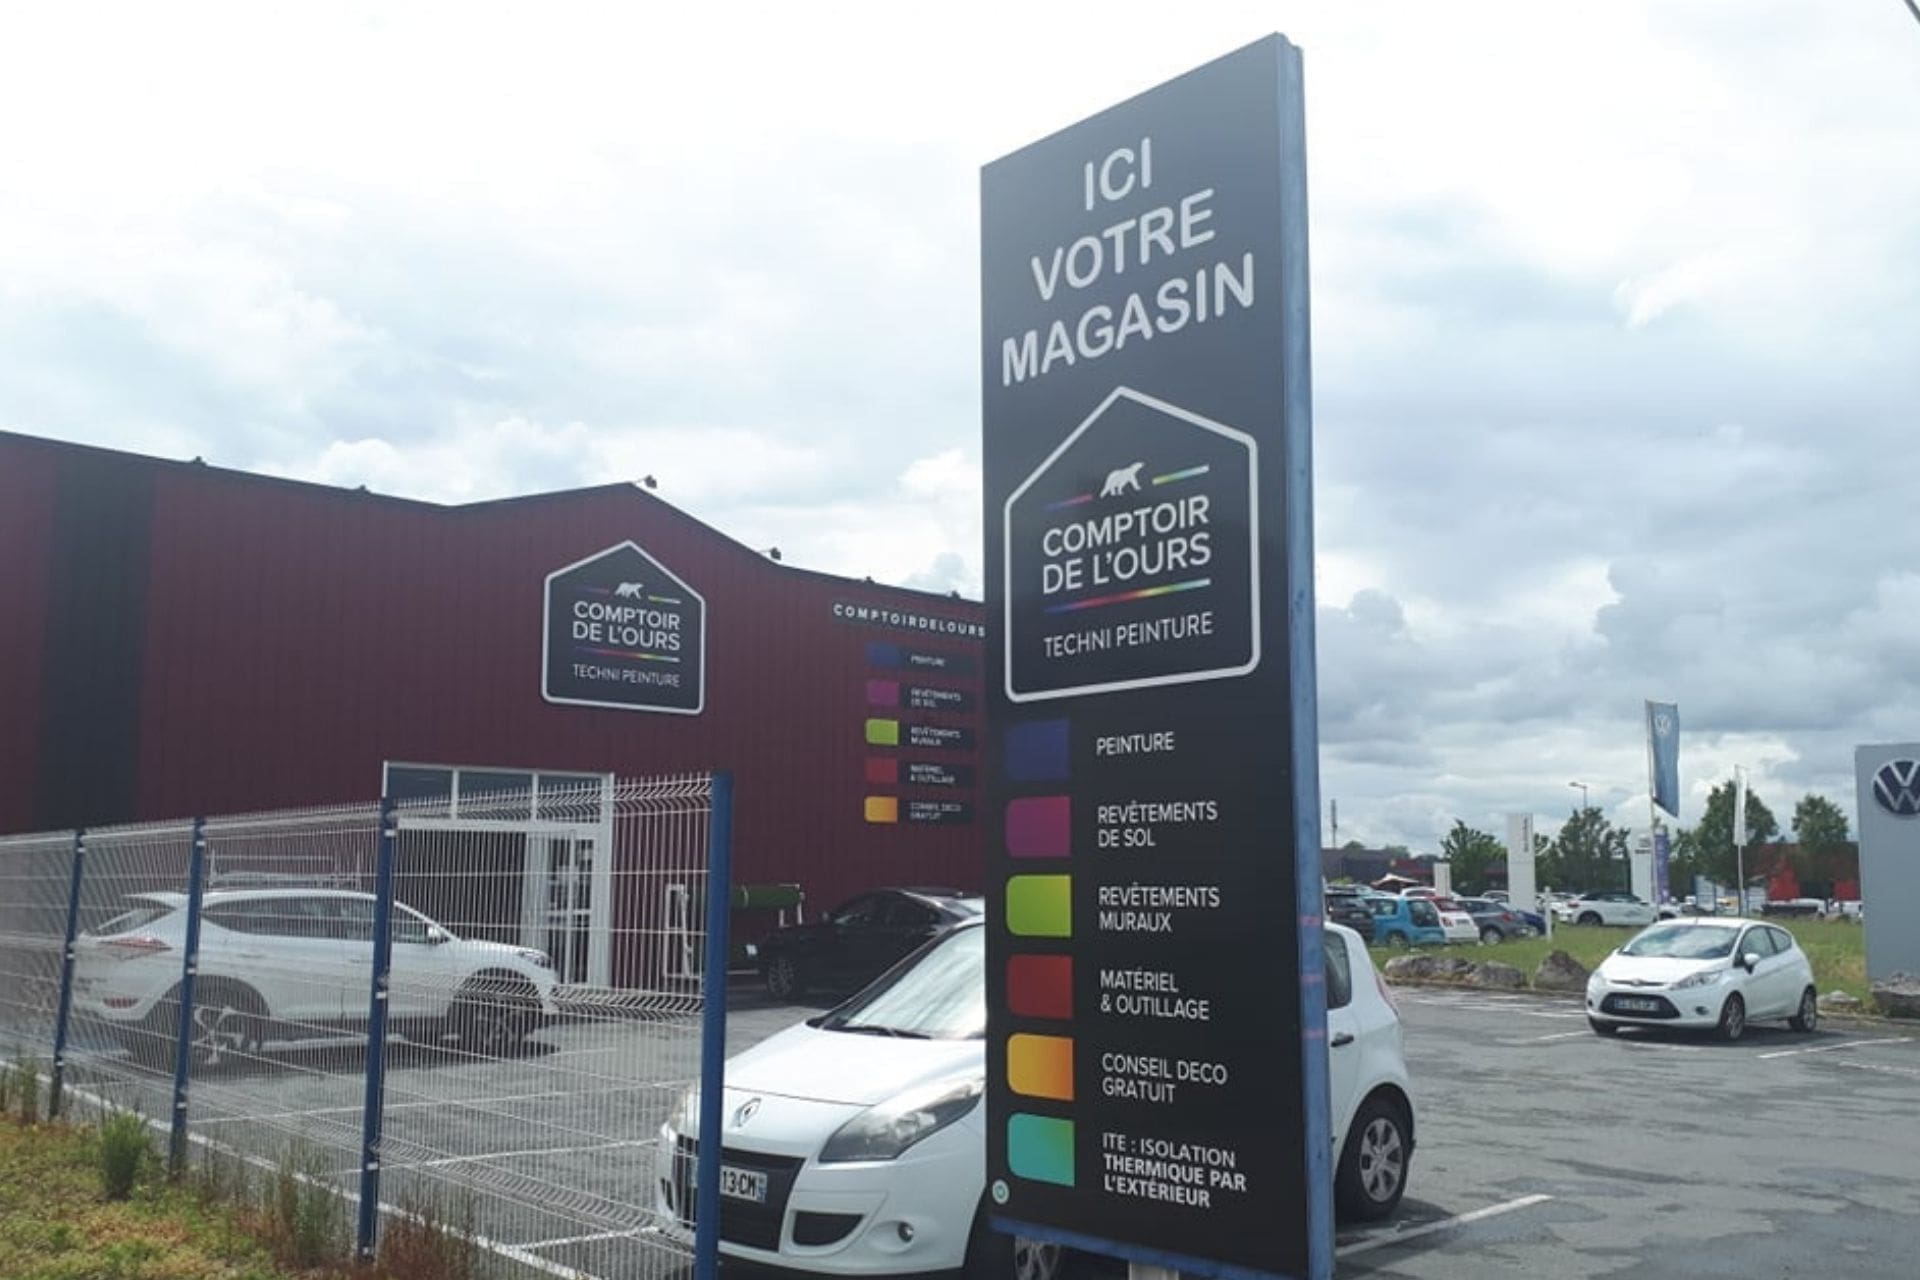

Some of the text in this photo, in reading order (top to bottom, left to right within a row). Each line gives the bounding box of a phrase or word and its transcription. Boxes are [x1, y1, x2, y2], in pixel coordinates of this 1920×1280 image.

[1084, 136, 1153, 211] ICI
[1031, 188, 1215, 301] VOTRE
[1002, 252, 1254, 387] MAGASIN
[1043, 494, 1210, 557] COMPTOIR
[1043, 557, 1083, 595] DE
[573, 600, 681, 630] COMPTOIR
[572, 621, 603, 642] DE
[1043, 611, 1214, 659] TECHNI PEINTURE
[573, 664, 681, 688] TECHNI PEINTURE
[1096, 731, 1175, 756] PEINTURE
[1097, 800, 1218, 824] REVÊTEMENTS
[1098, 828, 1156, 847] DE SOL
[1098, 882, 1220, 908] REVÊTEMENTS
[1099, 911, 1172, 932] MURAUX
[1100, 967, 1179, 993] MATÉRIEL
[1100, 994, 1210, 1020] & OUTILLAGE
[1101, 1052, 1228, 1085] CONSEIL DECO
[1102, 1077, 1176, 1103] GRATUIT
[1102, 1132, 1126, 1152] ITE
[1140, 1138, 1236, 1169] ISOLATION
[1103, 1153, 1247, 1192] THERMIQUE PAR
